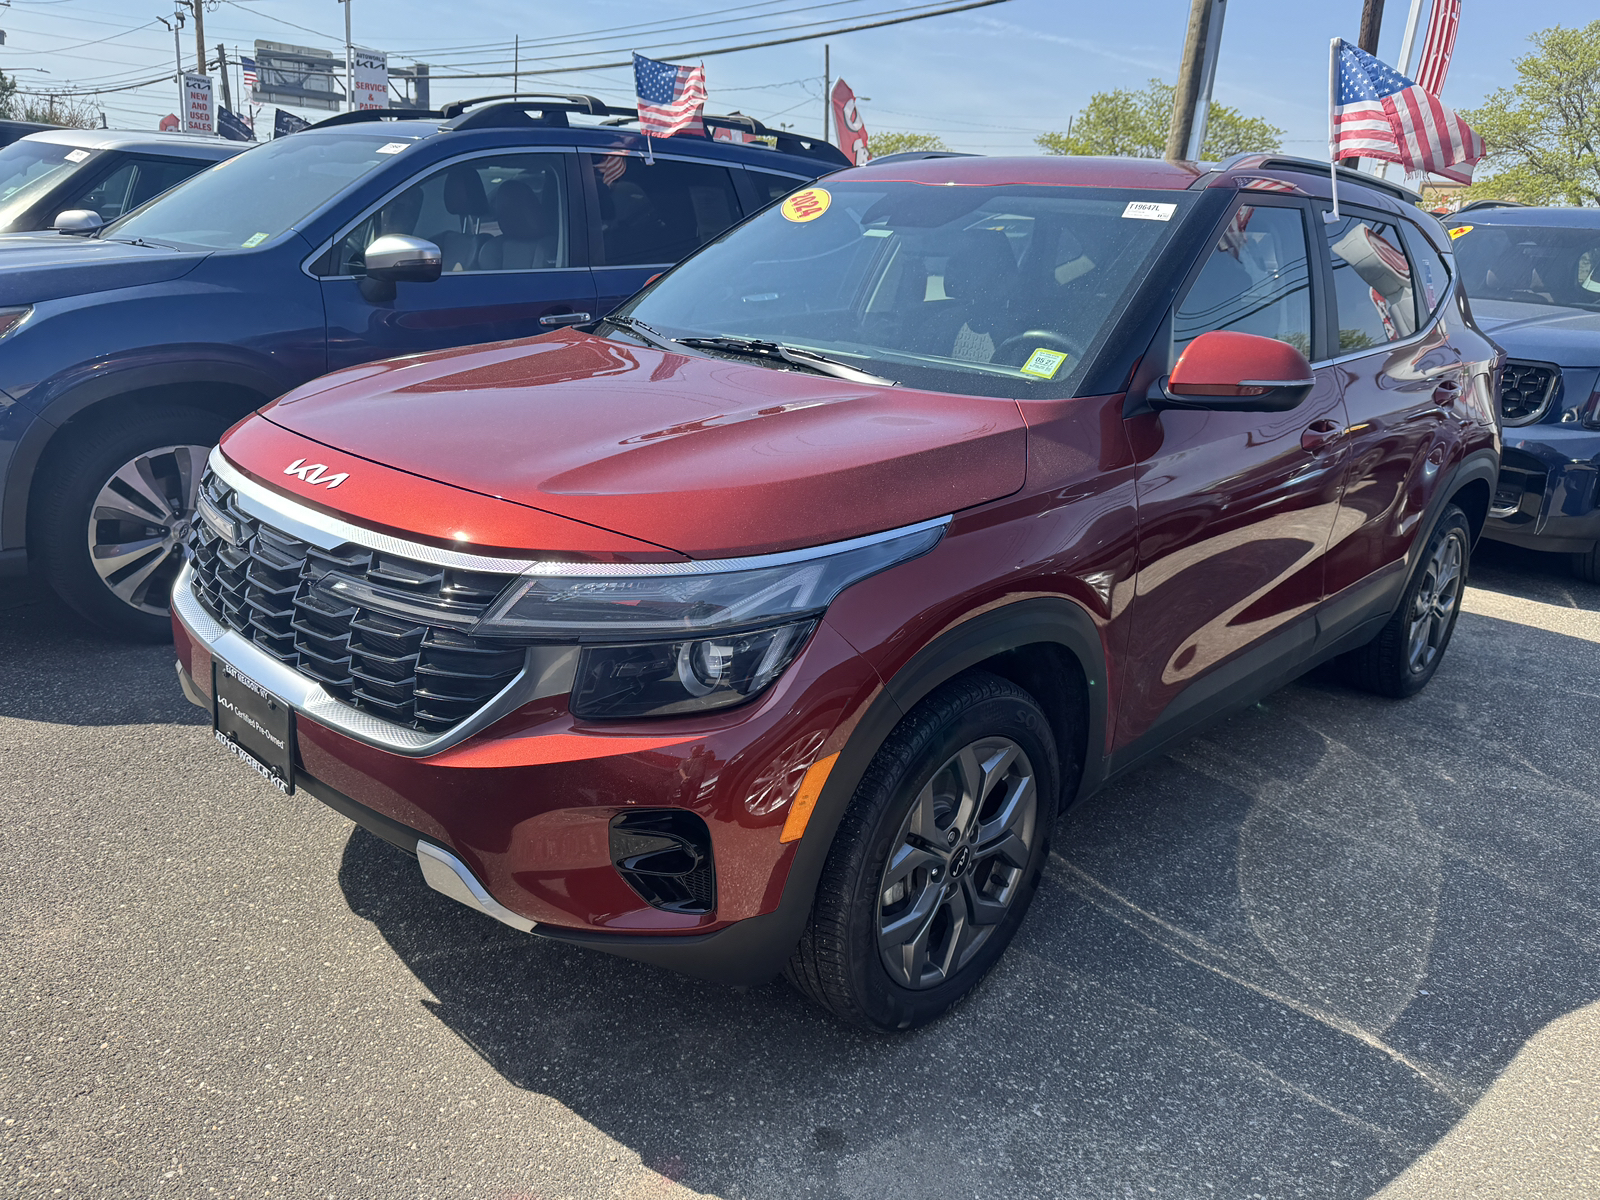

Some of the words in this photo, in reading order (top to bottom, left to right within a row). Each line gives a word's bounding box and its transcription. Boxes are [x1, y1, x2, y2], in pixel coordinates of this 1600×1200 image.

[356, 52, 386, 62] AUTOWORLD
[356, 60, 386, 71] KIA
[186, 81, 211, 91] KIA
[355, 81, 387, 93] SERVICE
[190, 91, 208, 101] NEW
[367, 93, 375, 102] &
[191, 101, 208, 111] AND
[190, 111, 210, 121] USED
[188, 120, 212, 132] SALES
[790, 191, 823, 219] 2024
[283, 457, 351, 490] KIA
[217, 694, 234, 711] KIA
[234, 706, 255, 729] Certified
[255, 721, 284, 750] Pre-Owned
[215, 731, 237, 754] AUTO
[238, 749, 268, 779] WORLD
[270, 774, 286, 794] KIA
